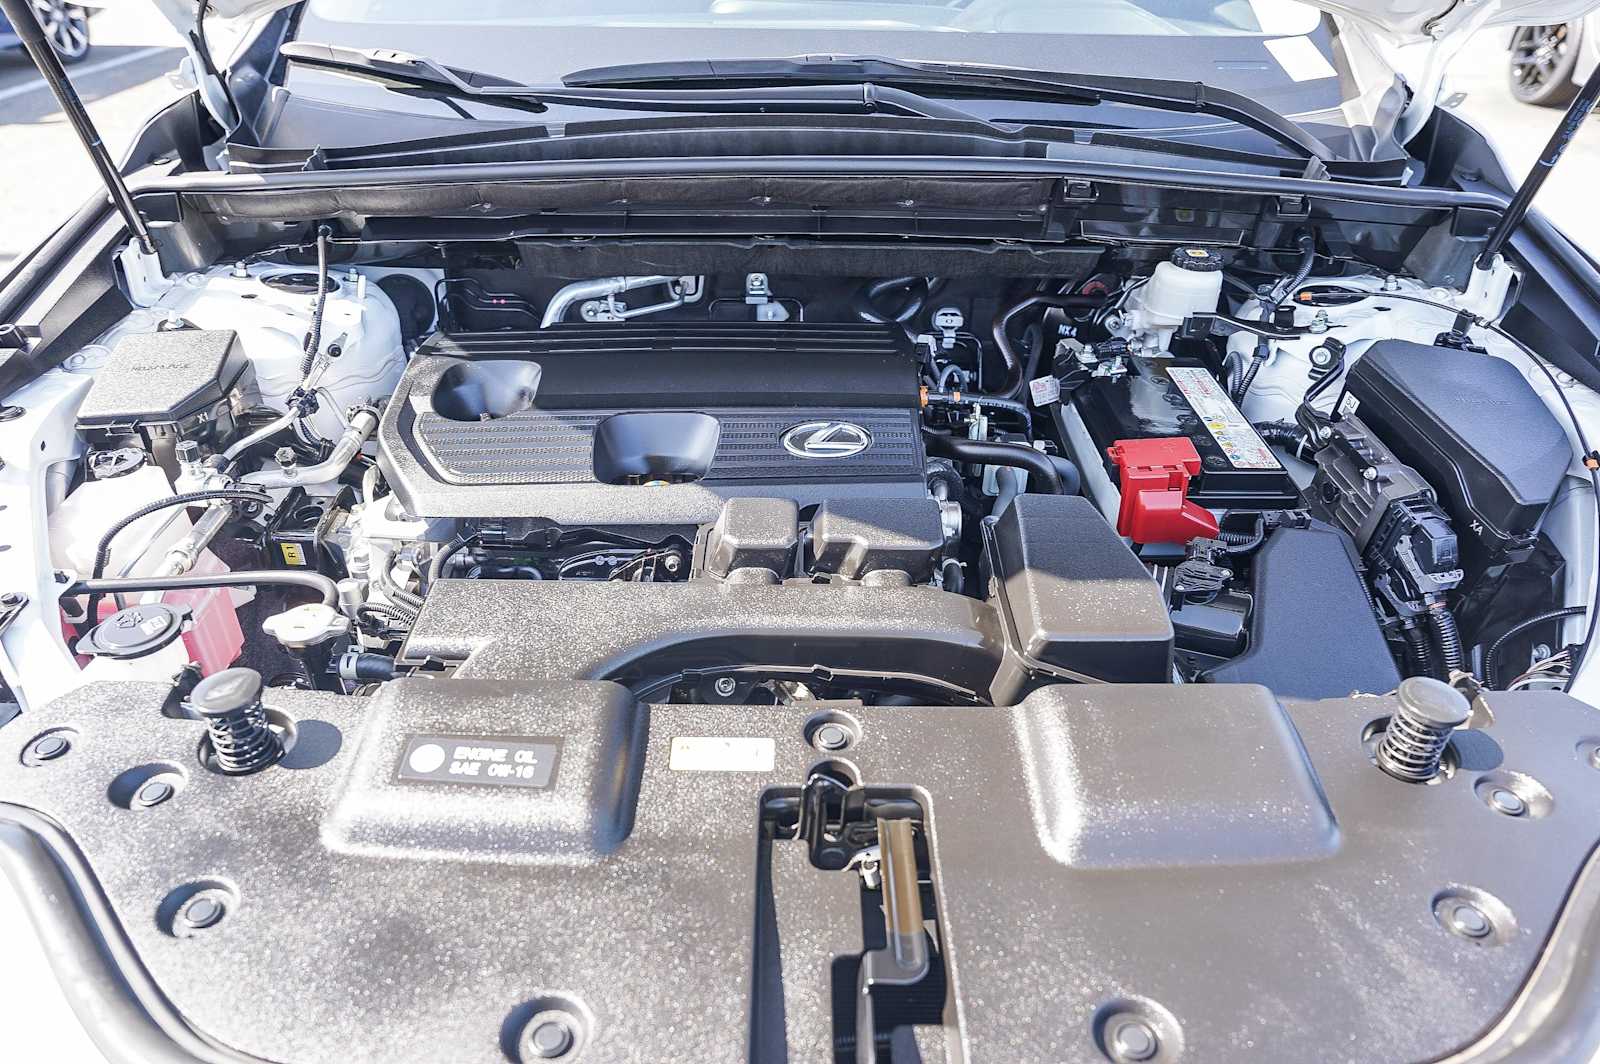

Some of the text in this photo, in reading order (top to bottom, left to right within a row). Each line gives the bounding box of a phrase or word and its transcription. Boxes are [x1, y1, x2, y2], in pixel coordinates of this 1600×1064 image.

[1469, 519, 1483, 535] XA
[453, 746, 538, 764] ENGINE OIL
[448, 760, 482, 776] SAE
